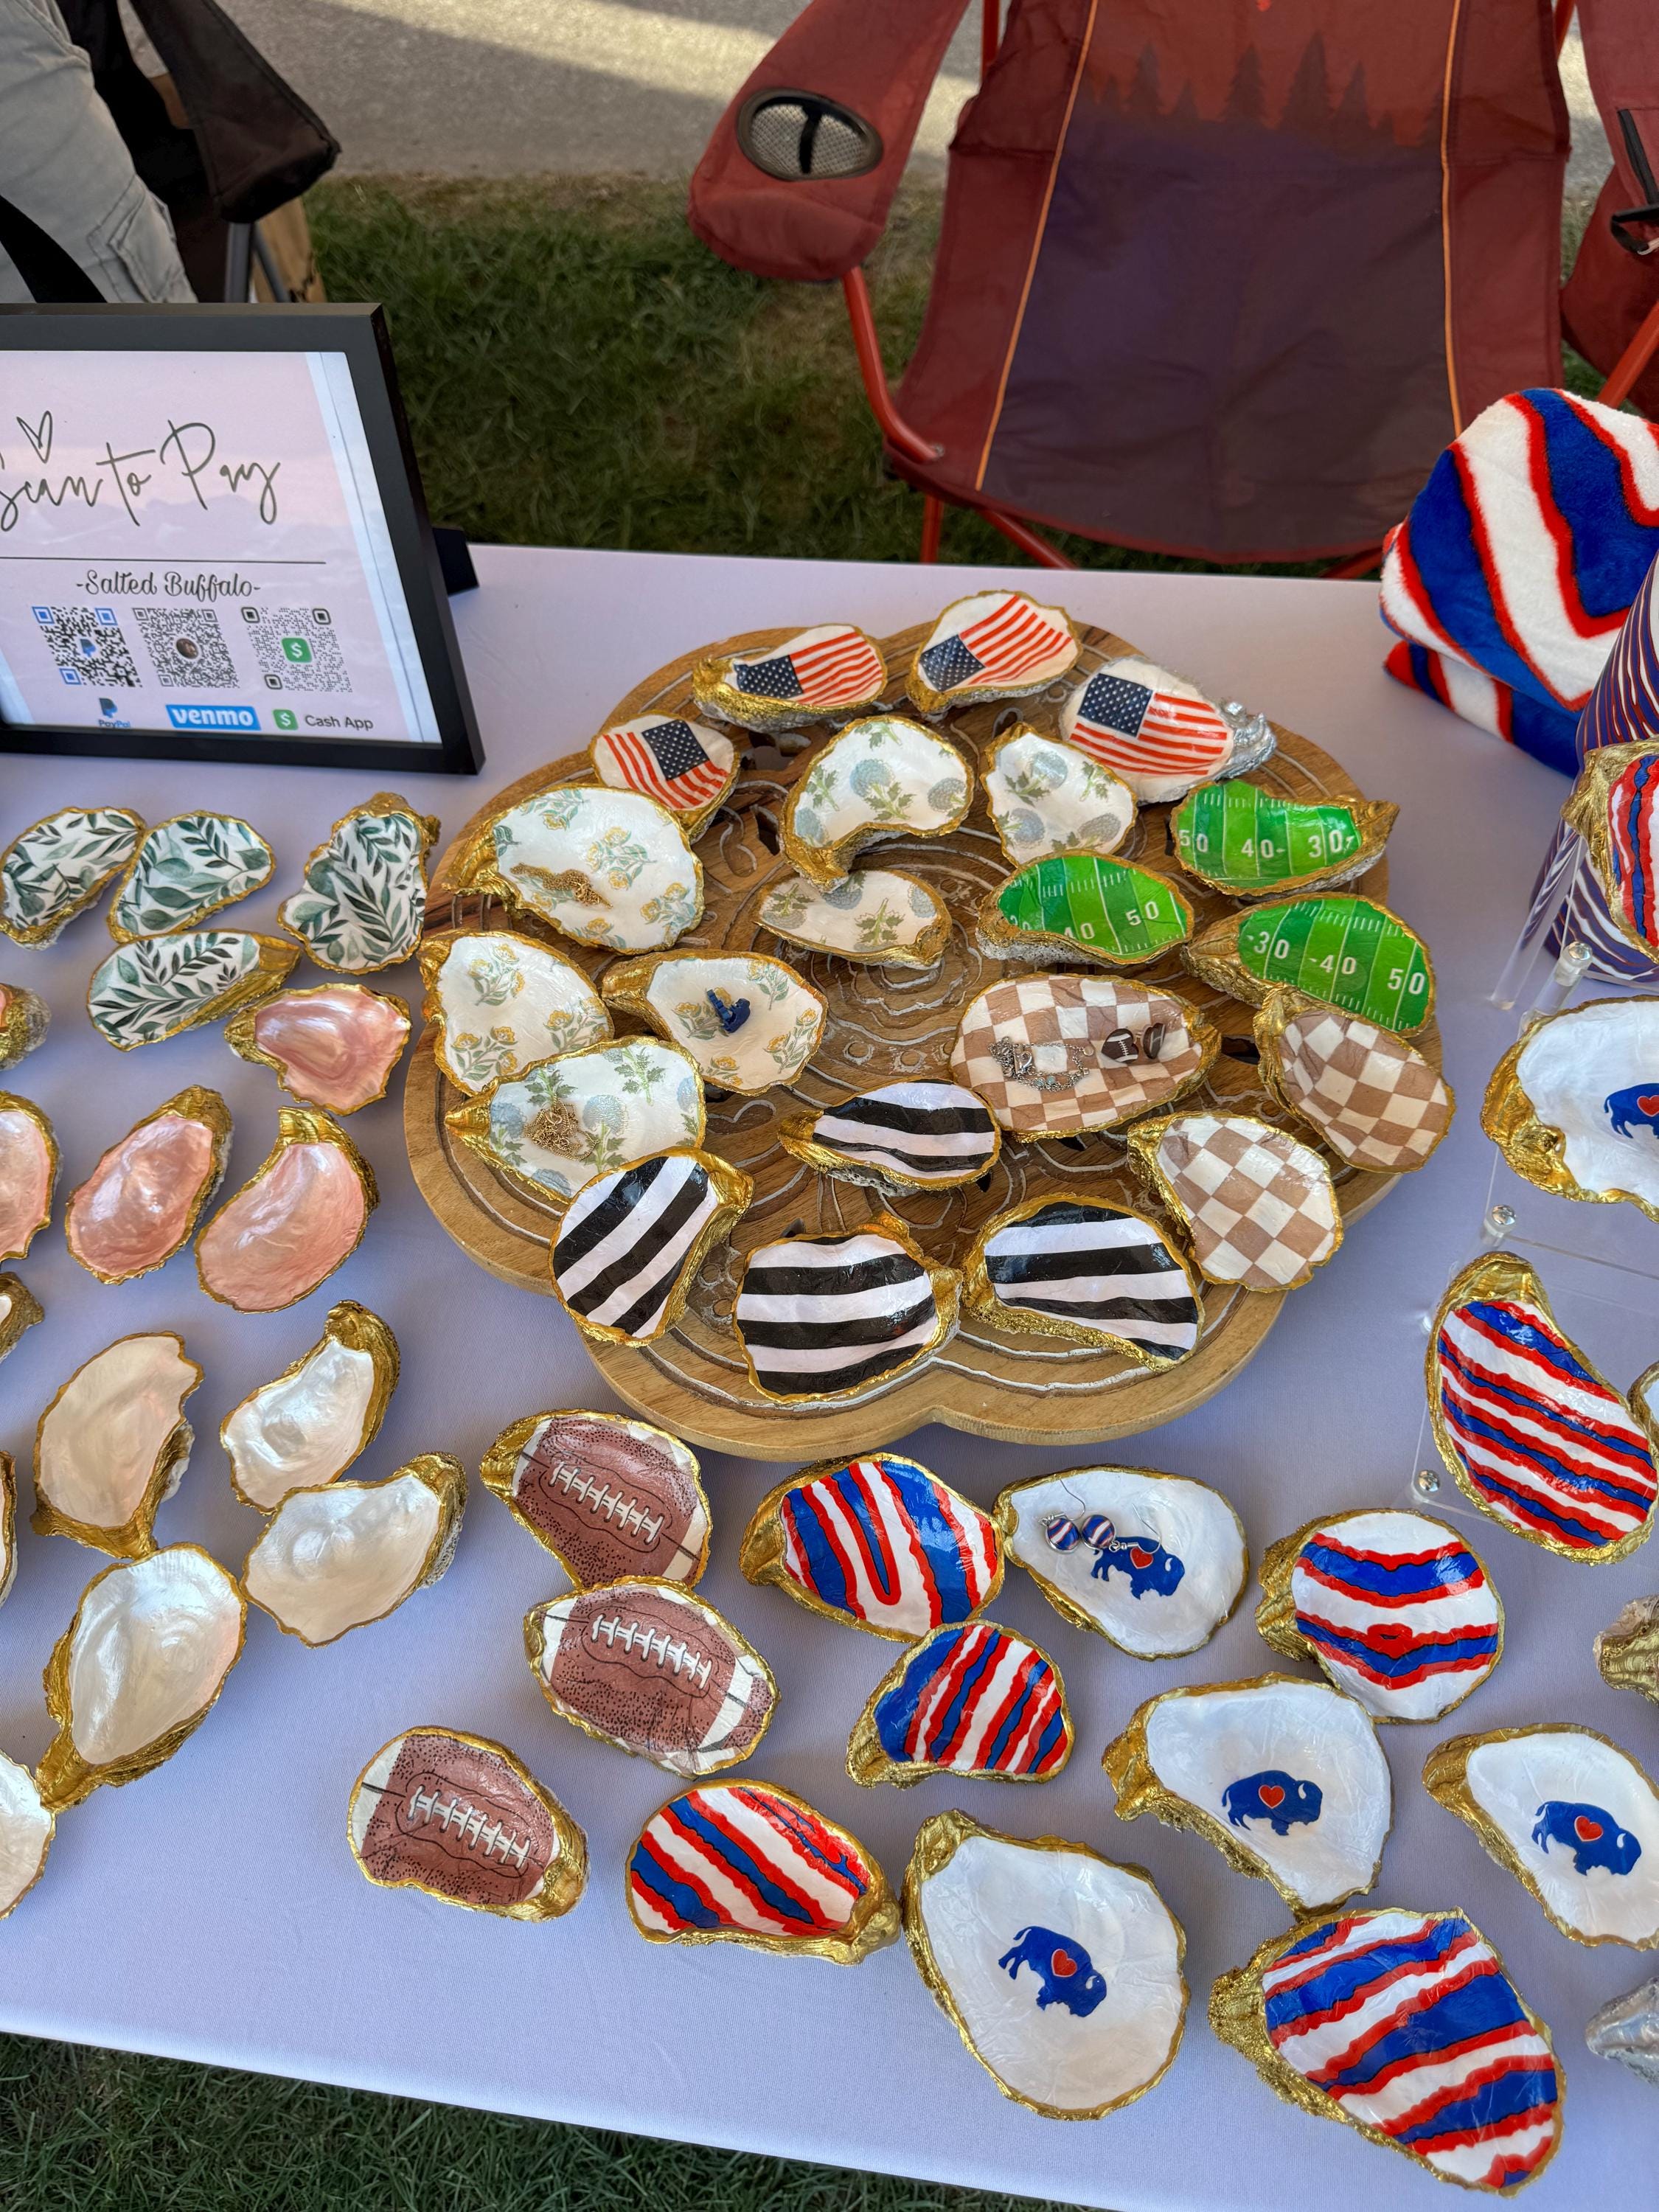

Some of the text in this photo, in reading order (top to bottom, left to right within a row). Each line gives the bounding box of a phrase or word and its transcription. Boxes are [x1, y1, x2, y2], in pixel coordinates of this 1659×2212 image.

[95, 442, 156, 526] to
[160, 420, 280, 525] Pay
[98, 719, 131, 728] PayPal
[172, 709, 254, 727] venmo
[305, 714, 339, 728] Cash
[344, 717, 374, 730] App
[1126, 900, 1160, 926] 50
[1387, 967, 1425, 995] 50
